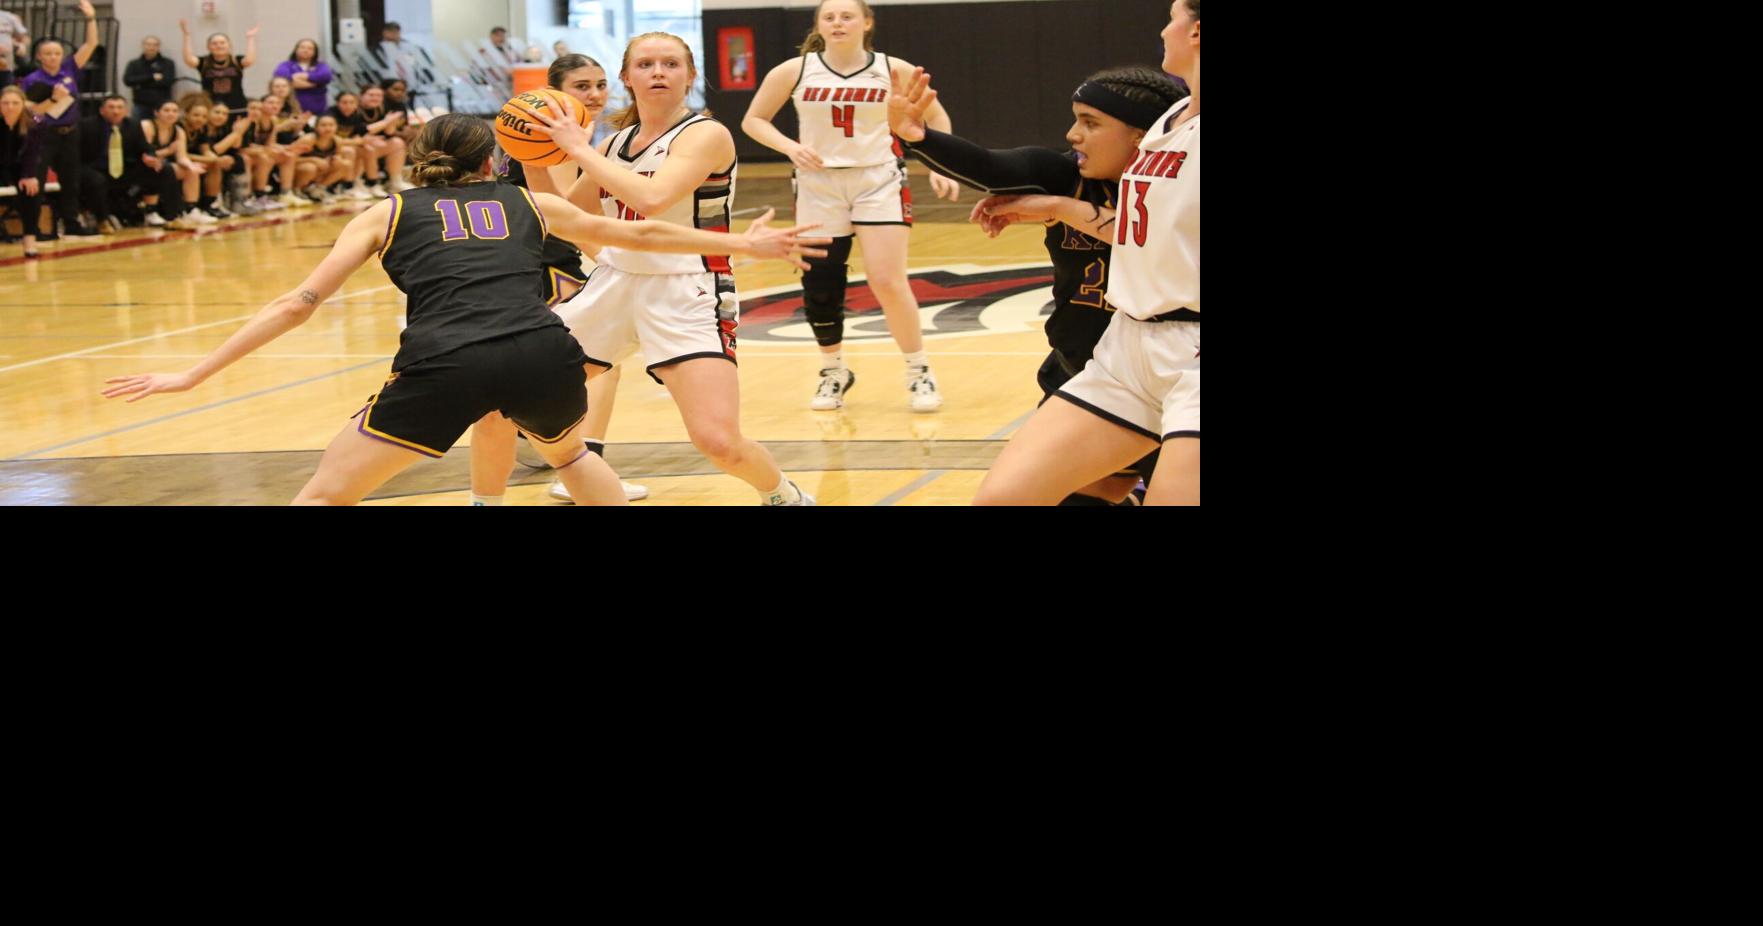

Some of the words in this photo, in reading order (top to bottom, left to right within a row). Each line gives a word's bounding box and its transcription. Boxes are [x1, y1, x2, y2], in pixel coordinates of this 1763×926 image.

[832, 104, 855, 137] 4
[434, 199, 510, 242] 10
[1117, 179, 1152, 247] 13
